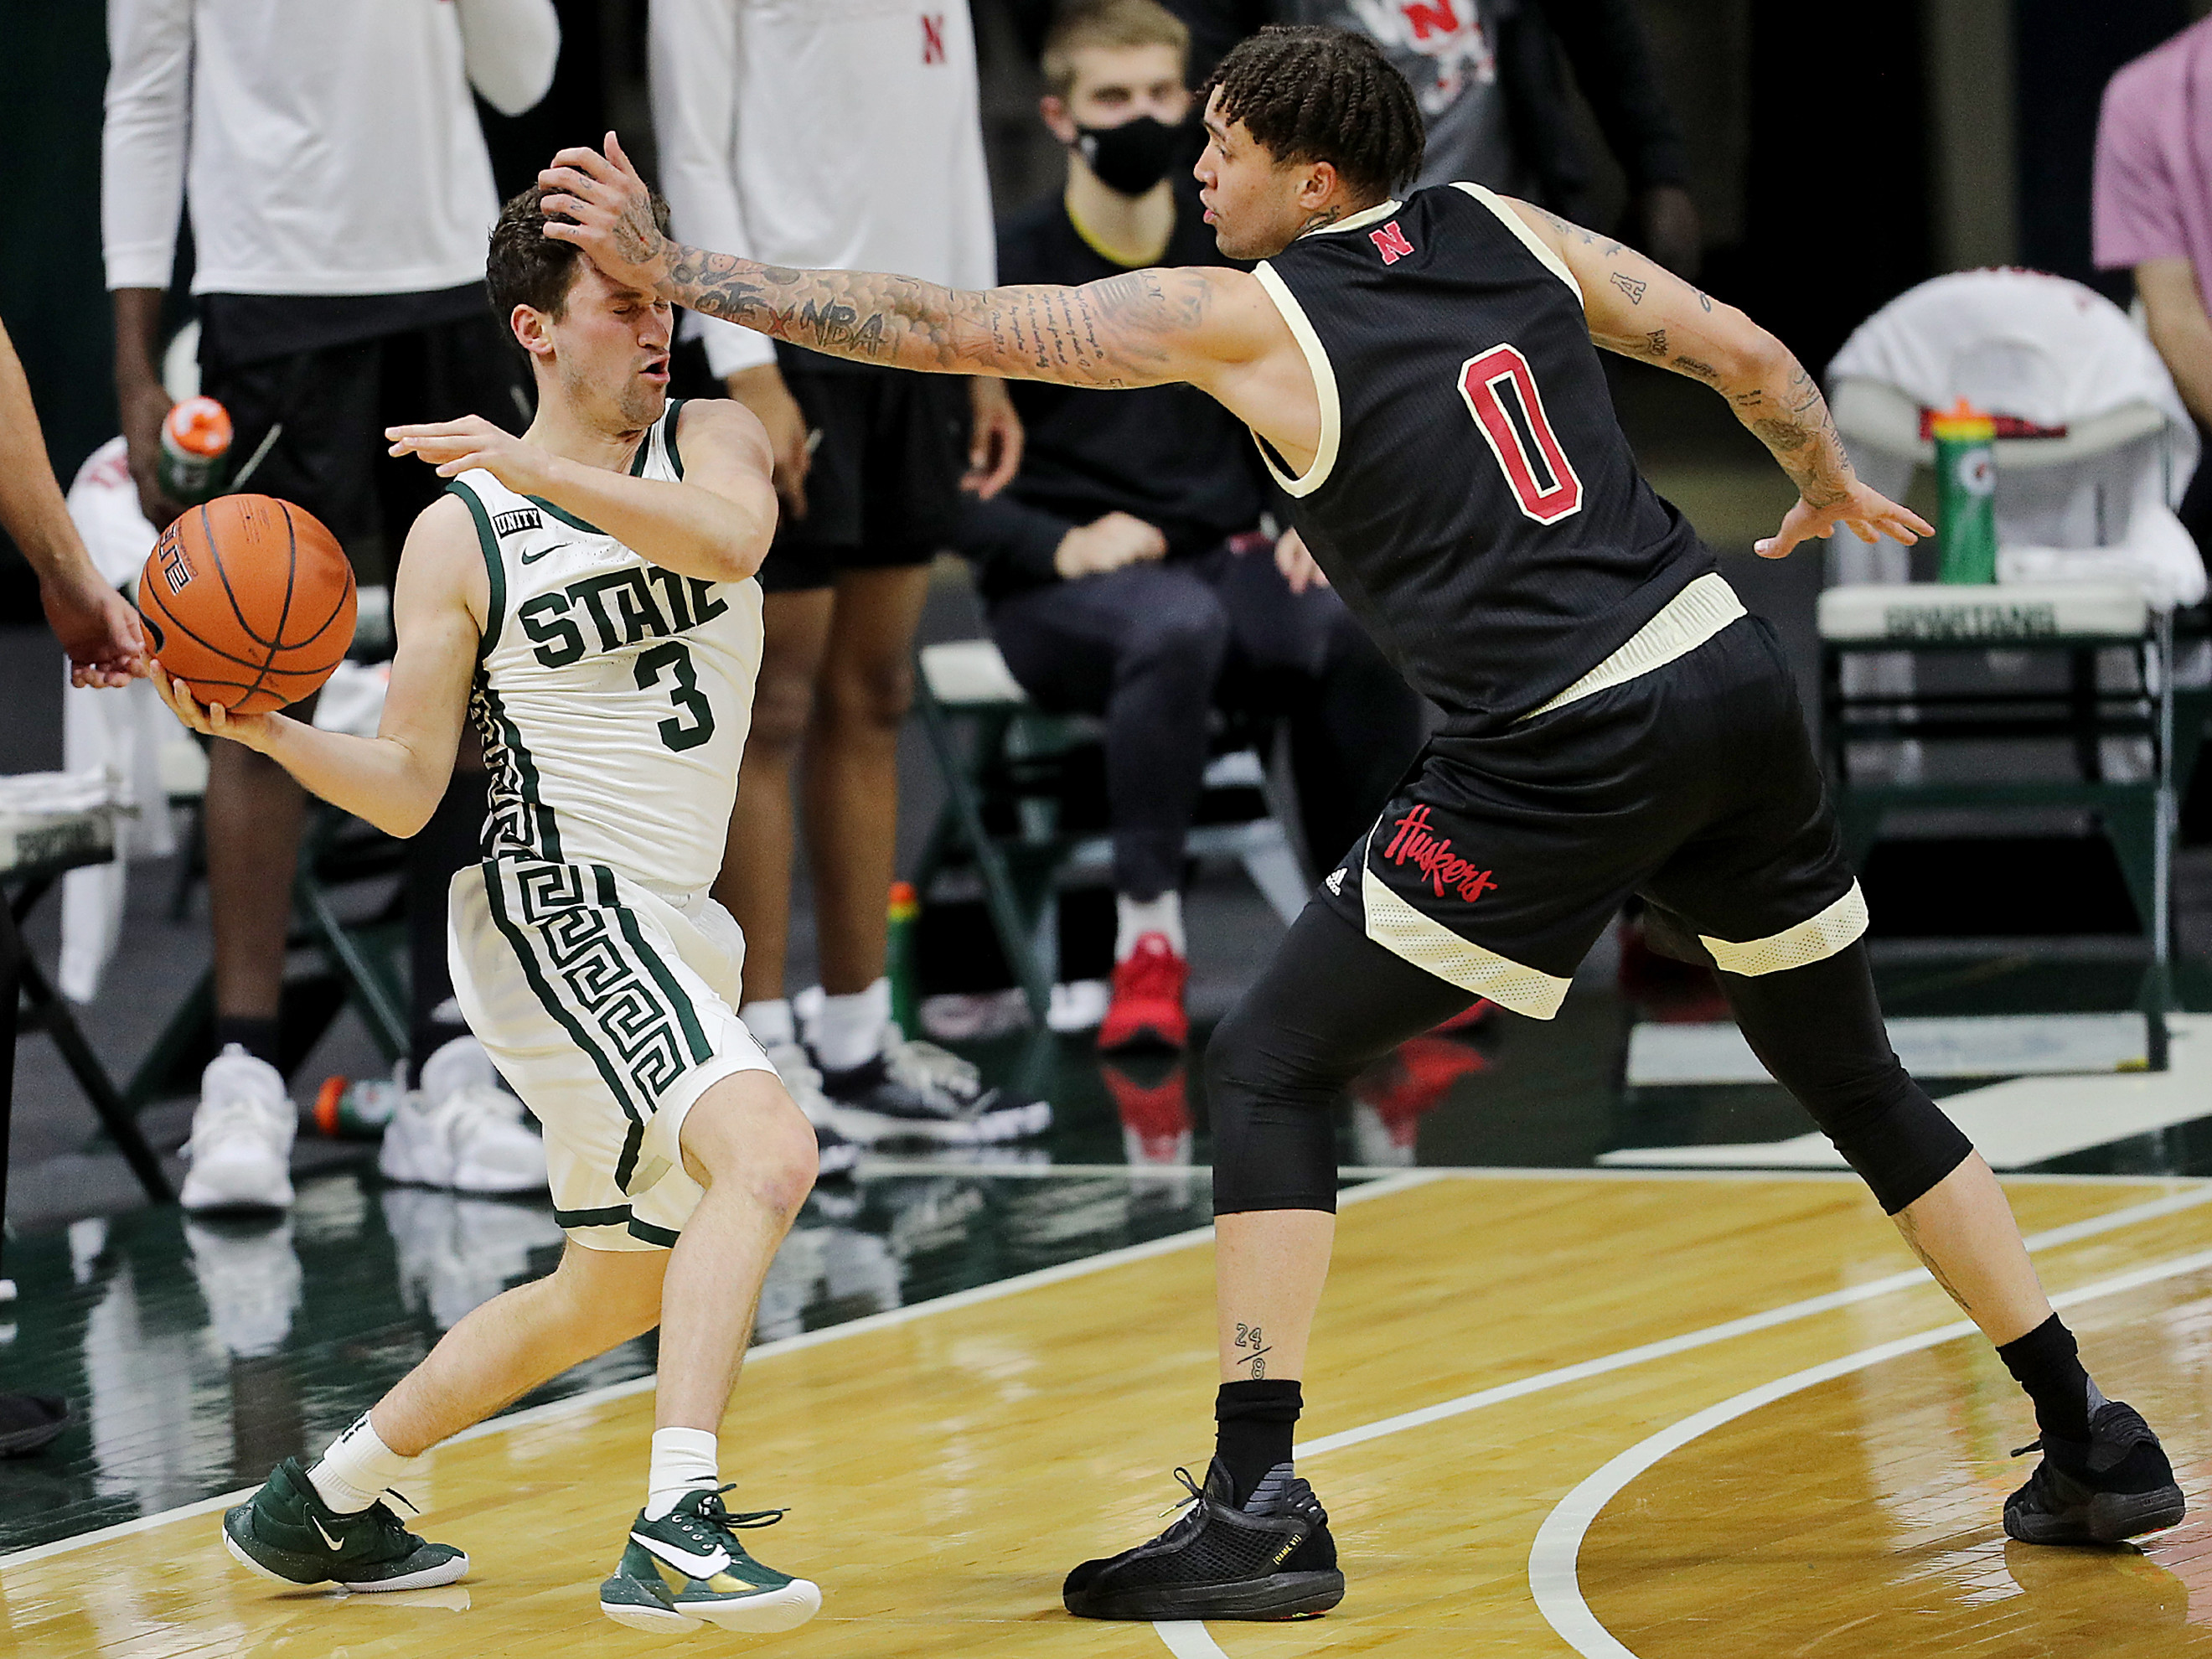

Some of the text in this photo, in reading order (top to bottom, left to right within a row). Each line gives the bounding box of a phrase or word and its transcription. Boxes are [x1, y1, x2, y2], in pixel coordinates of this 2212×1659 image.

[920, 14, 946, 64] N
[1368, 220, 1415, 266] N
[800, 297, 886, 357] NBA
[1456, 342, 1584, 526] 0
[496, 509, 540, 535] UNITY
[633, 641, 716, 752] 3
[1384, 804, 1498, 903] Huskers
[1235, 1323, 1262, 1350] 24
[1251, 1357, 1265, 1380] 8
